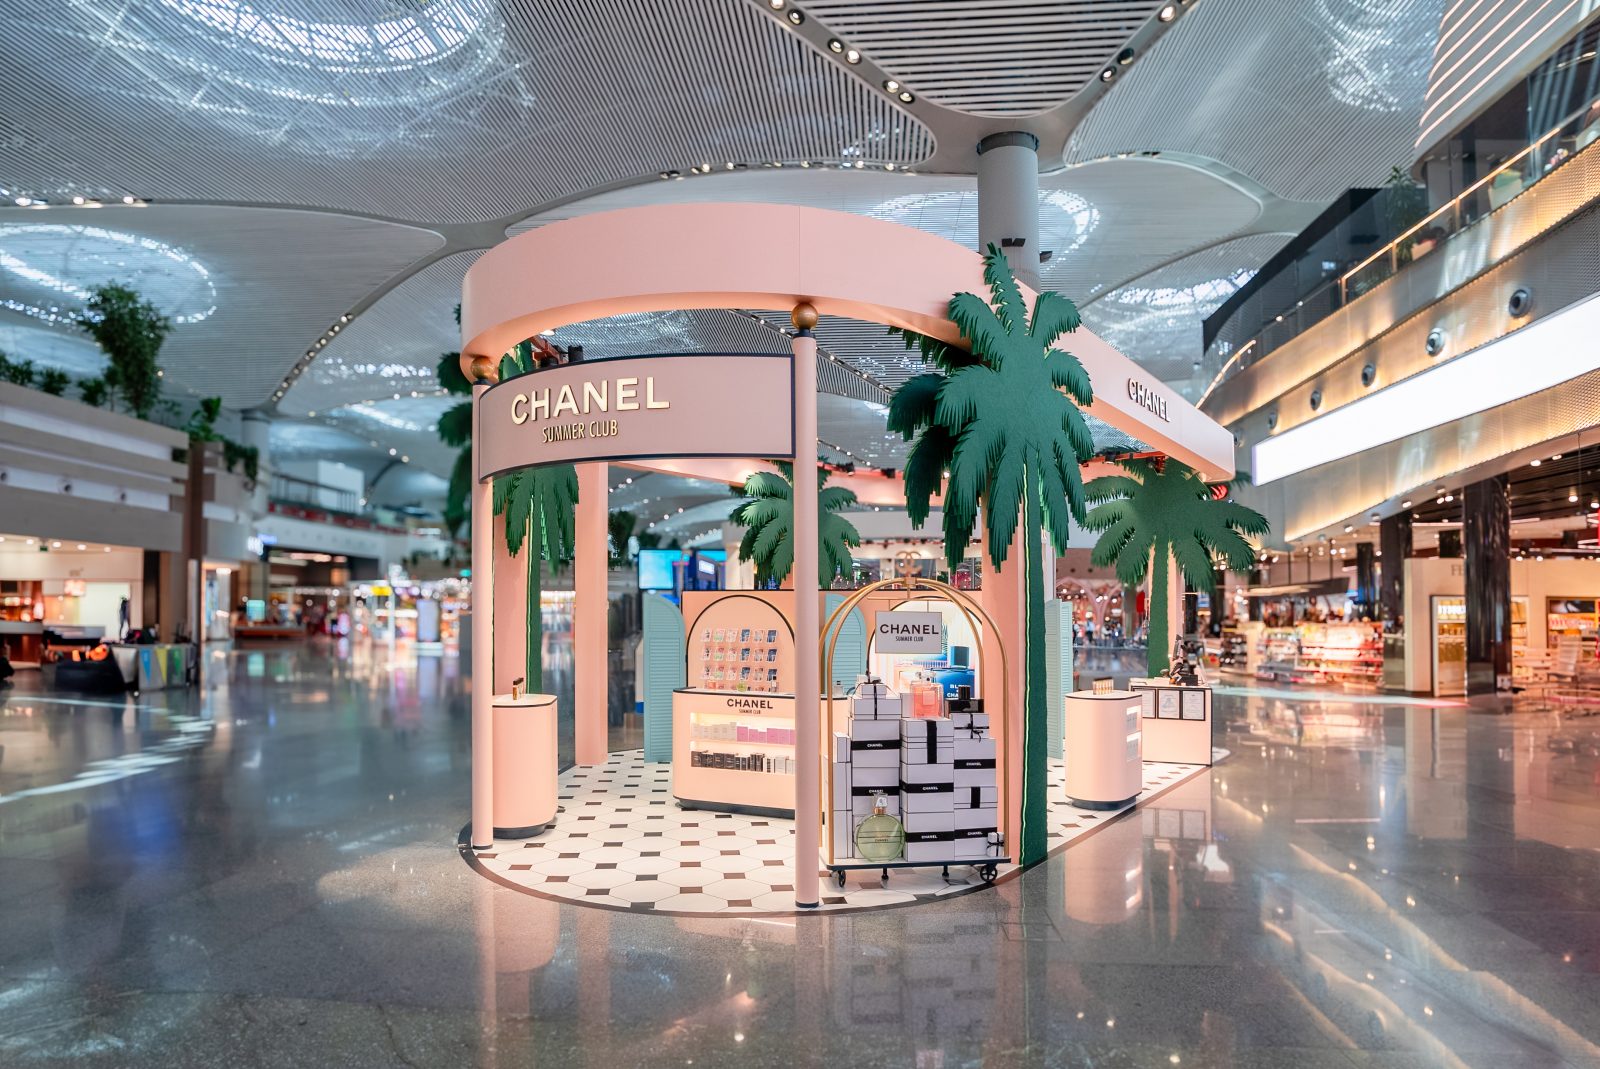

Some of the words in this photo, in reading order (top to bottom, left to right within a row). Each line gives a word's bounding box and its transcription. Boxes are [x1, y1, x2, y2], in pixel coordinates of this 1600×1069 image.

[511, 376, 670, 425] CHANEL
[1127, 378, 1170, 423] CHANEL
[543, 422, 585, 443] SUMMER
[589, 419, 618, 437] CLUB
[880, 624, 939, 635] CHANEL
[727, 699, 773, 709] CHANEL
